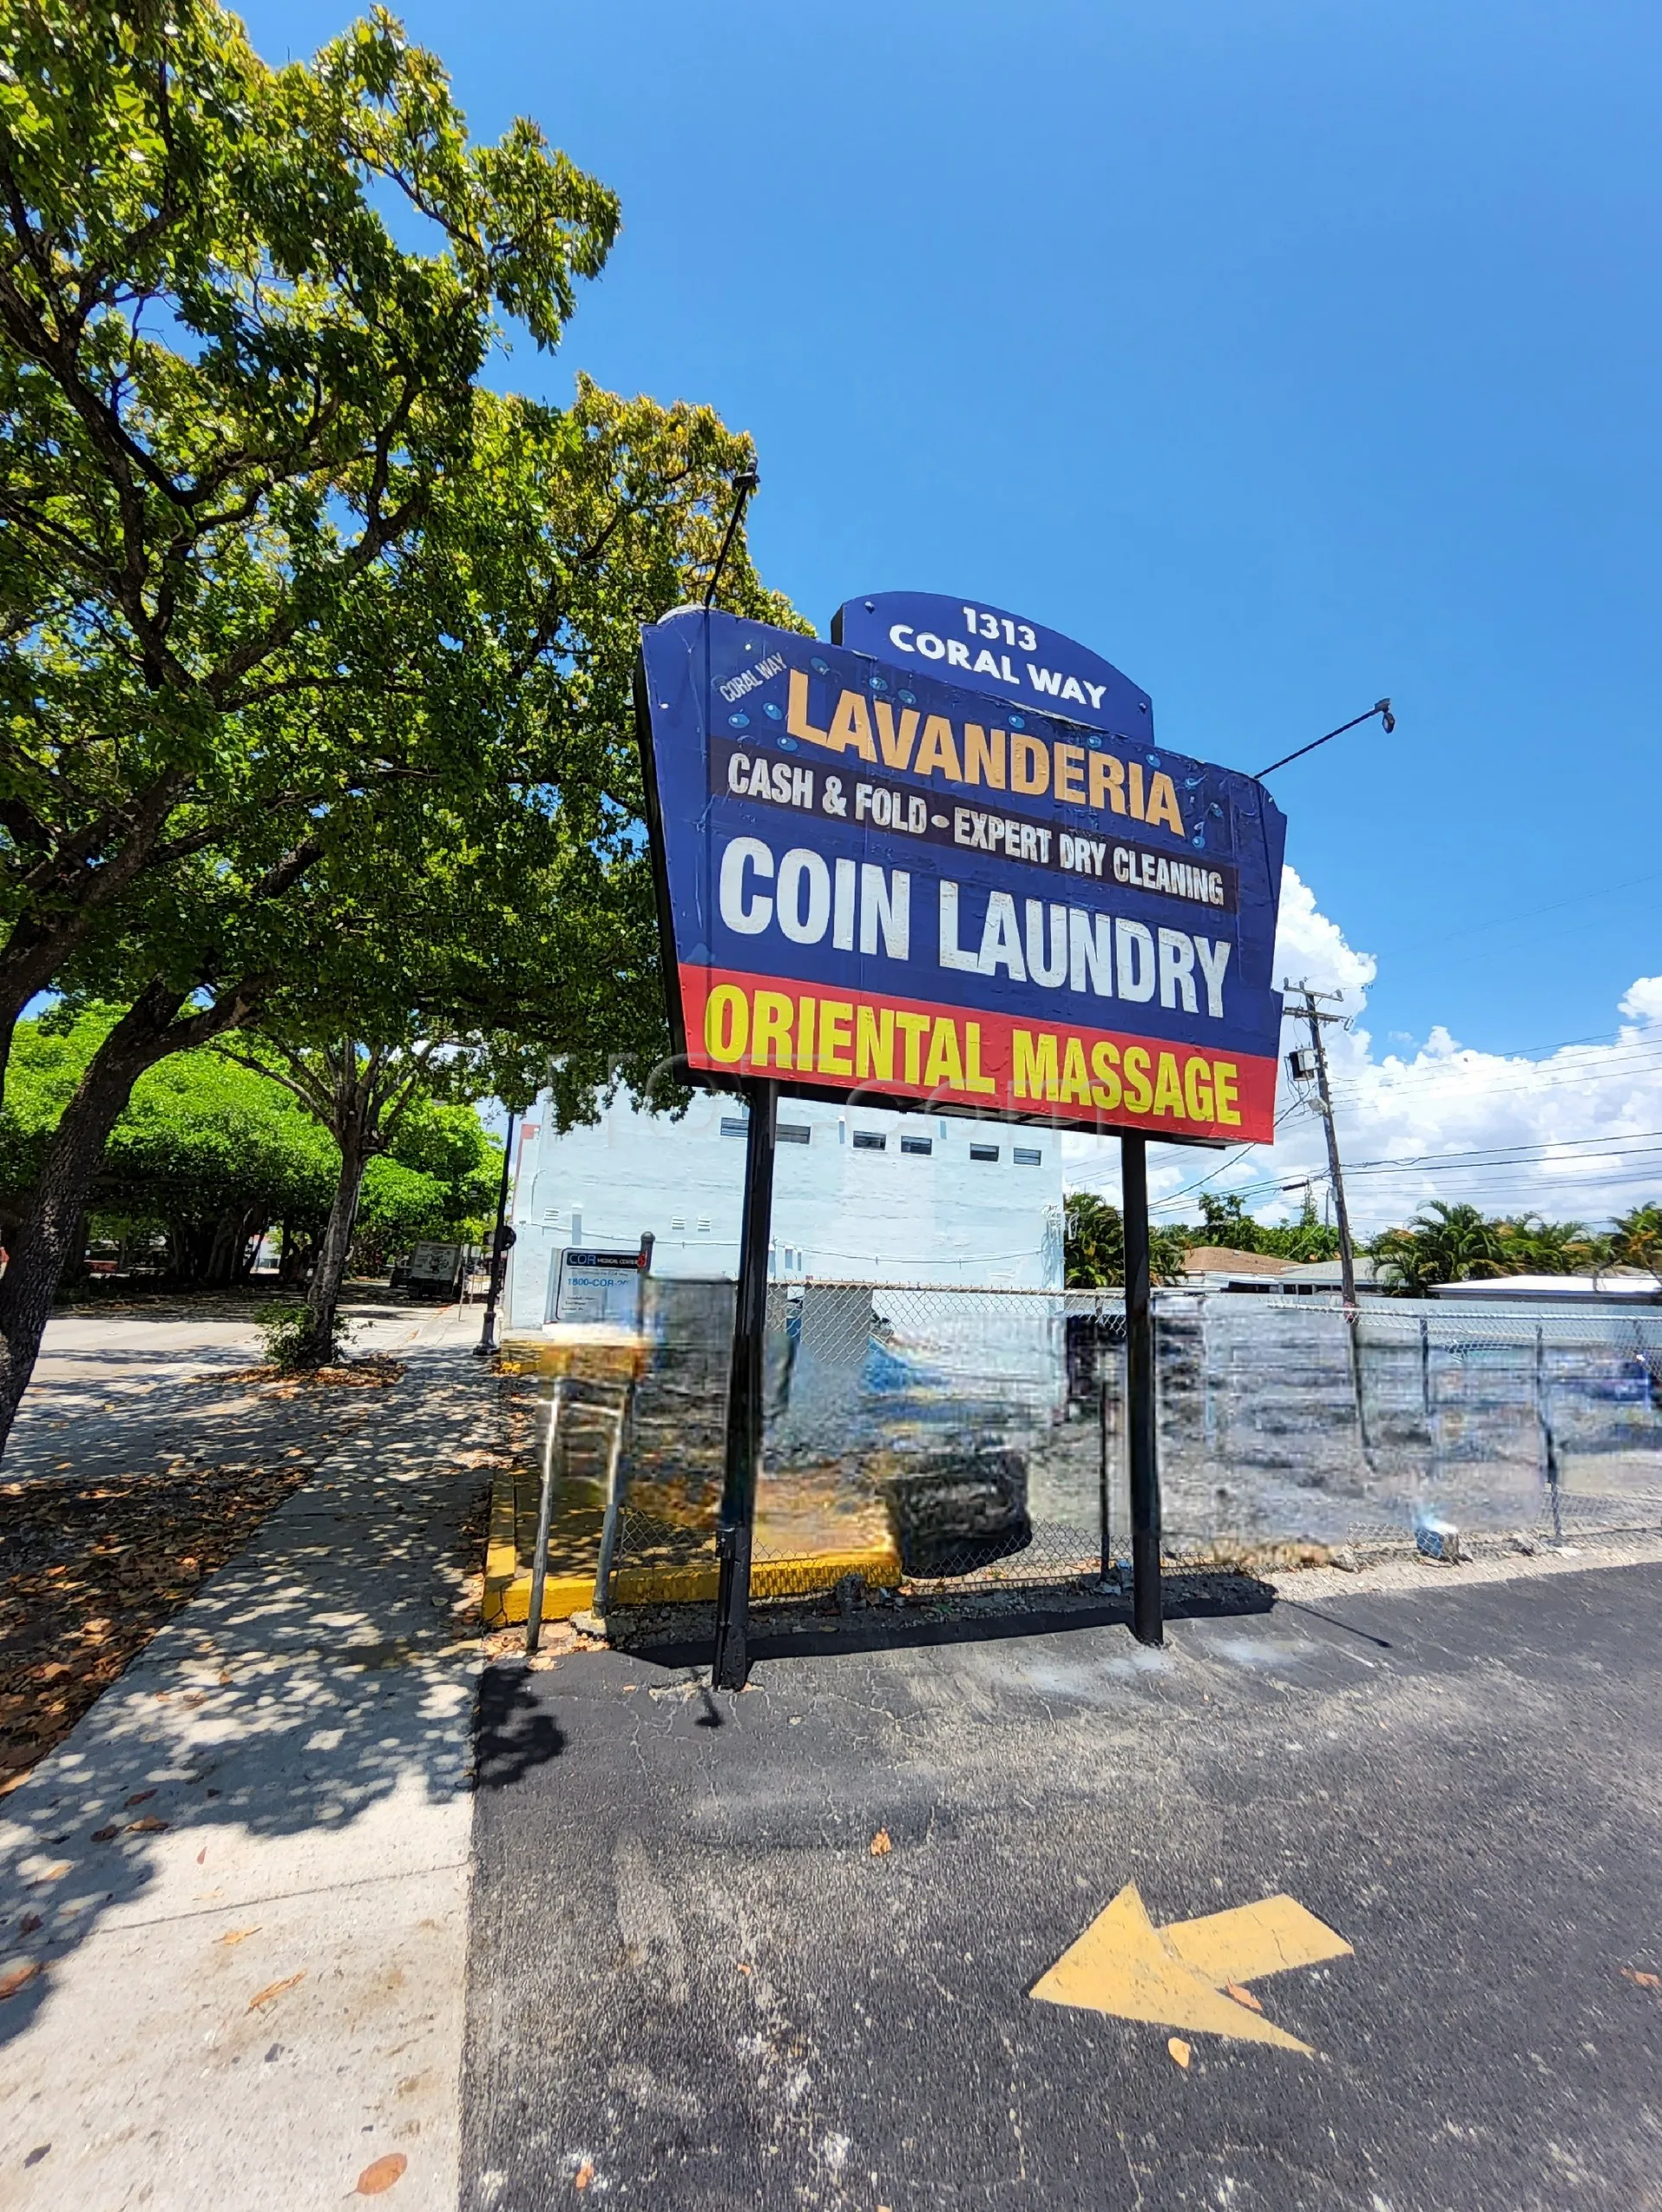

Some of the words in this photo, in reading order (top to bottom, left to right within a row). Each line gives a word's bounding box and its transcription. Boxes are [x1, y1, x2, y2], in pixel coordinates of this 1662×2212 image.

[719, 670, 763, 703] CORAL
[755, 652, 788, 684] WAY
[889, 623, 1021, 685] CORAL
[1026, 663, 1107, 709] WAY
[963, 606, 1037, 652] 1313
[786, 668, 1184, 834] LAVANDERIA
[728, 752, 813, 810] CASH
[822, 775, 848, 817] &
[855, 782, 927, 834] FOLD
[954, 807, 1053, 863] EXPERT
[1060, 833, 1107, 877] DRY
[1112, 846, 1225, 906] CLEANING
[719, 836, 911, 962] COIN
[939, 880, 1232, 1020] LAUNDRY
[704, 982, 997, 1094] ORIENTAL
[1013, 1030, 1242, 1126] MASSAGE
[570, 1253, 596, 1266] COR
